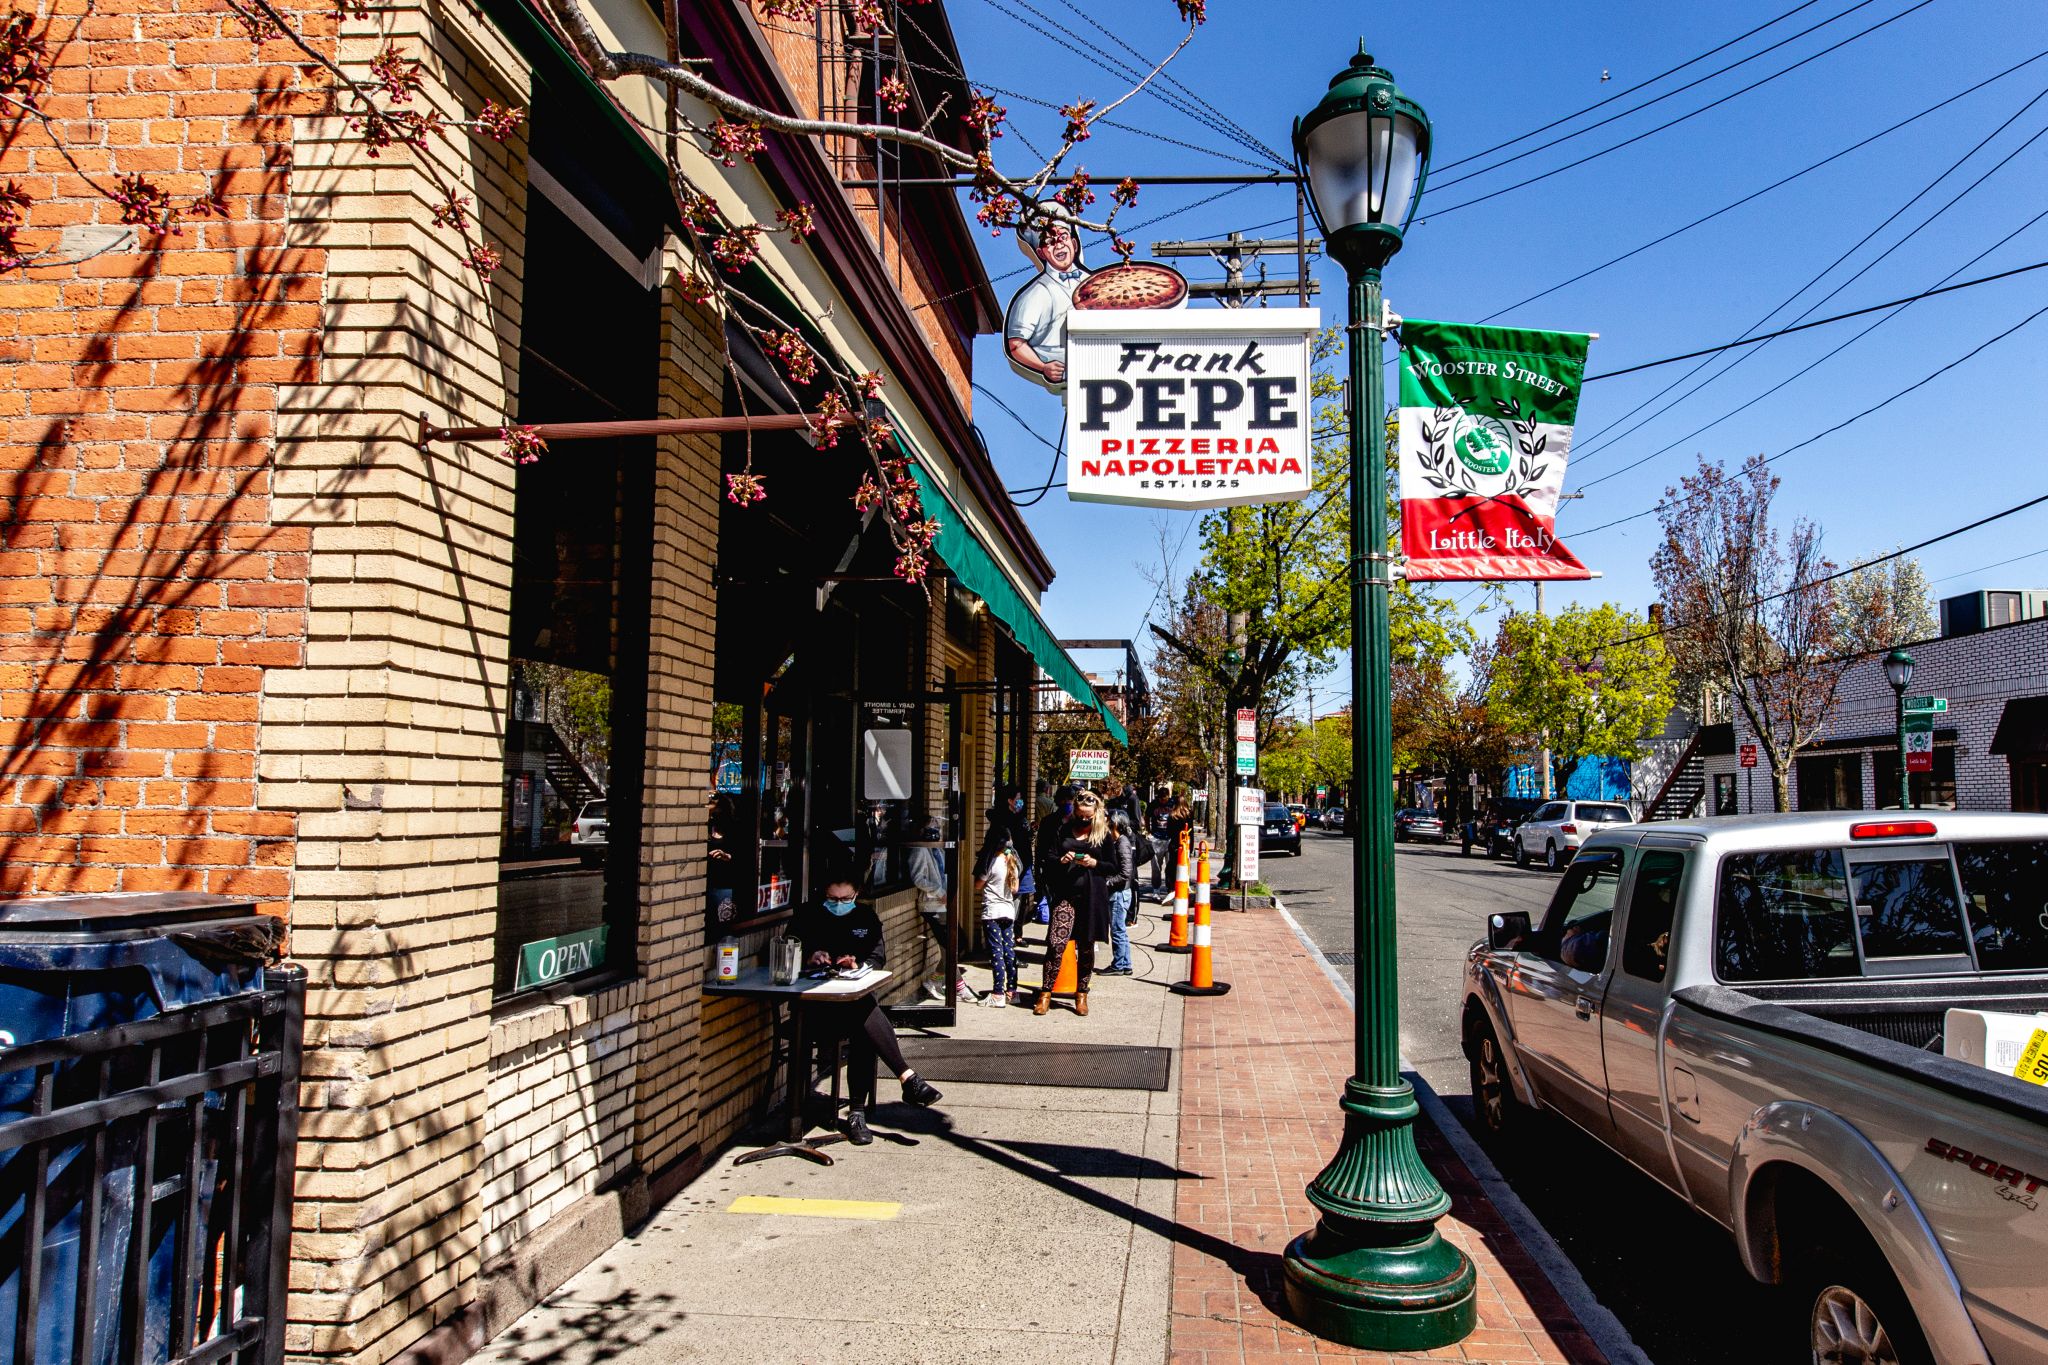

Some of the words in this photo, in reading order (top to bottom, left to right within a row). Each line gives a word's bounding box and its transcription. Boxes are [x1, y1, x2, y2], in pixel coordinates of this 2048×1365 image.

[1118, 341, 1266, 375] Frank
[1079, 377, 1298, 431] PEPE
[1101, 437, 1280, 455] PIZZERIA
[1081, 458, 1302, 476] NAPOLETANA
[1463, 456, 1497, 472] WOOSTER
[1140, 480, 1185, 489] EST.
[1192, 479, 1240, 488] 1925
[1430, 528, 1495, 550] Little
[1505, 526, 1556, 554] Italy
[538, 939, 594, 980] OPEN
[1924, 1137, 2048, 1195] SPORT
